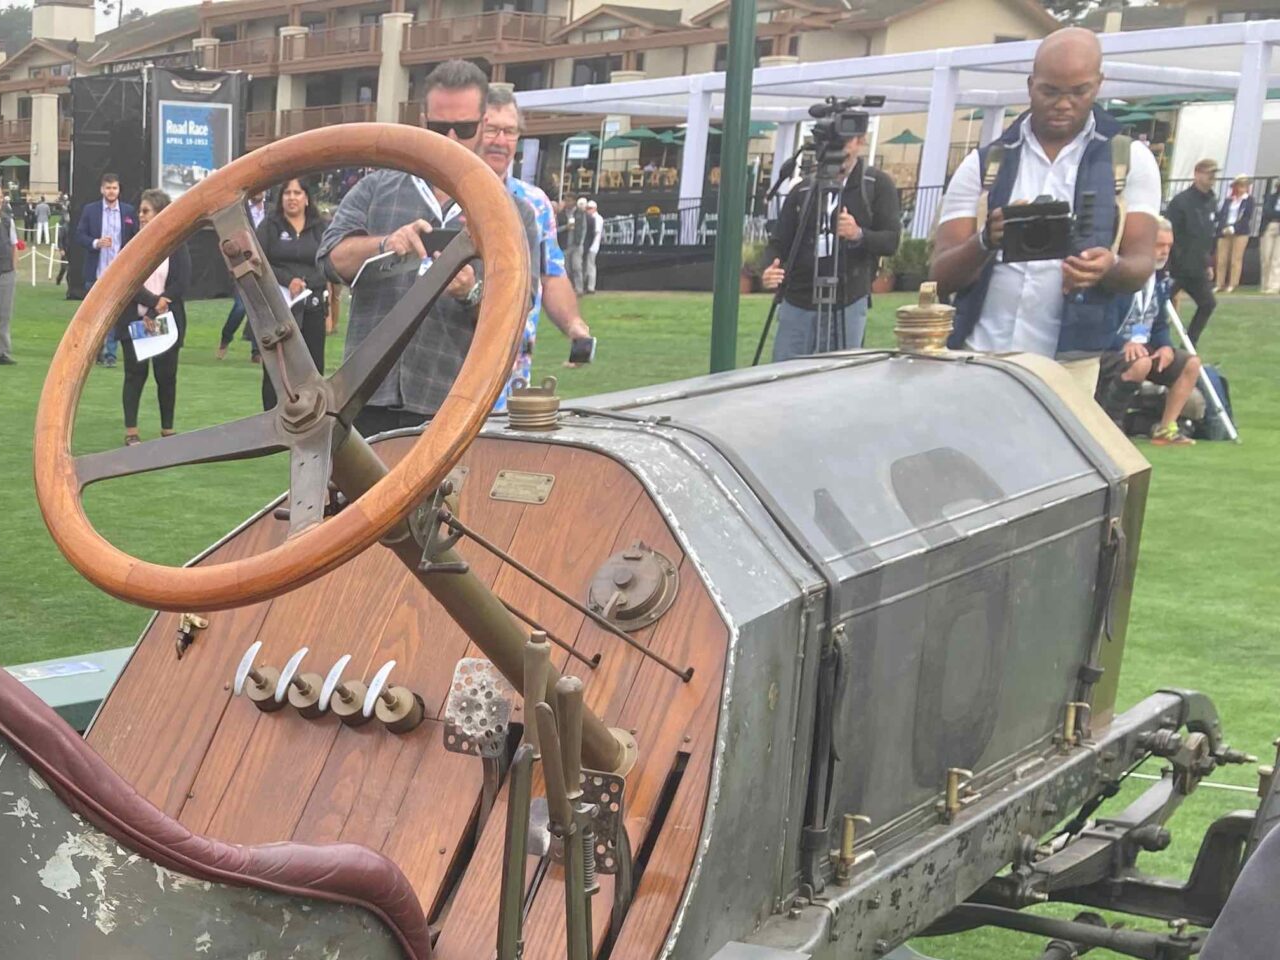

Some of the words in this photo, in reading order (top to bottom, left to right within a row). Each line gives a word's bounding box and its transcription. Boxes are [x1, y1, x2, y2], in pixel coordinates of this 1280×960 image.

[166, 120, 187, 135] Road
[189, 120, 209, 136] Race
[166, 137, 183, 145] APRIL
